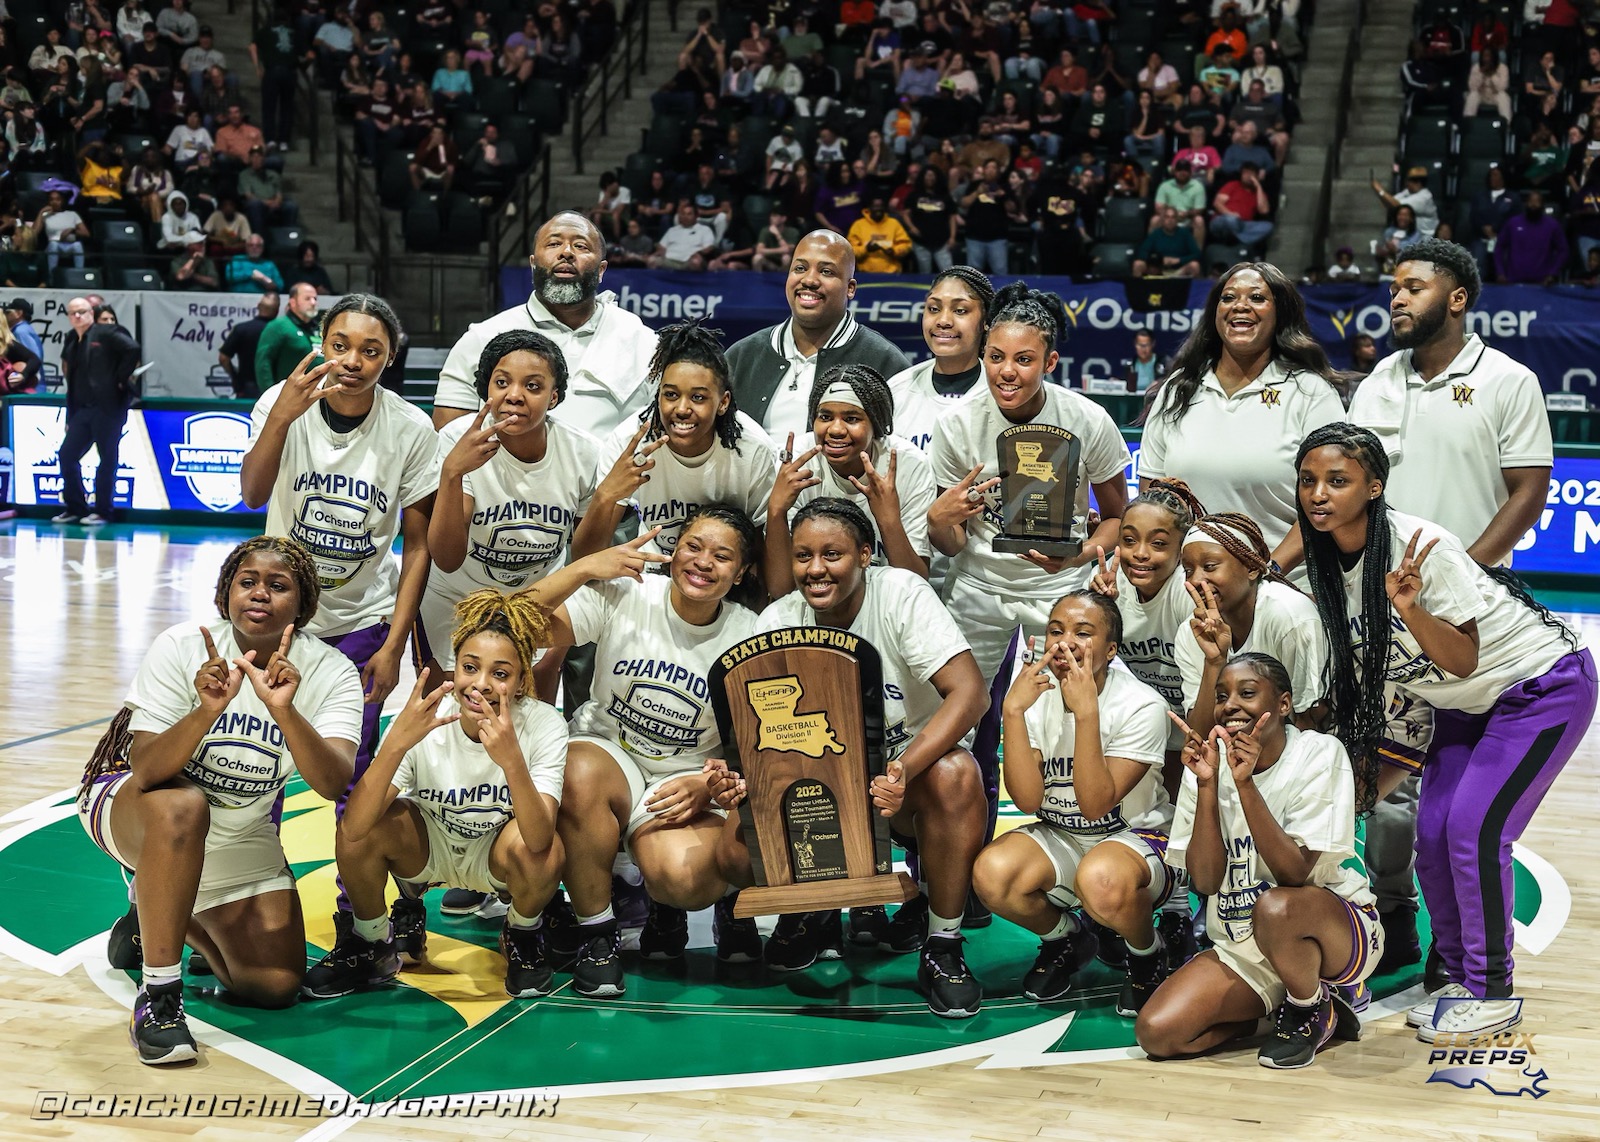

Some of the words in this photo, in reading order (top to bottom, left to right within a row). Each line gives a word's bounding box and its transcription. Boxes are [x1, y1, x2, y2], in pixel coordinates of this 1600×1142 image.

[615, 286, 723, 318] hsner
[170, 318, 214, 350] Lady
[1004, 424, 1046, 438] OUTSTANDING
[1048, 426, 1072, 440] PLAYER
[294, 471, 388, 514] CHAMPIONS
[315, 511, 364, 529] Ochsner
[294, 526, 371, 550] BASKETBALL
[506, 538, 557, 550] Ochsner
[478, 547, 558, 563] BASKETBALL
[722, 634, 769, 670] STATE
[771, 629, 859, 652] CHAMPION
[612, 659, 710, 703] CHAMPIO
[614, 700, 696, 740] BASKETBALL
[642, 698, 692, 722] Ochsner
[207, 712, 288, 750] AMPIO
[766, 720, 819, 734] BASKETBALL
[776, 731, 805, 740] Division
[216, 757, 273, 774] Ochsner
[796, 785, 822, 798] 2023
